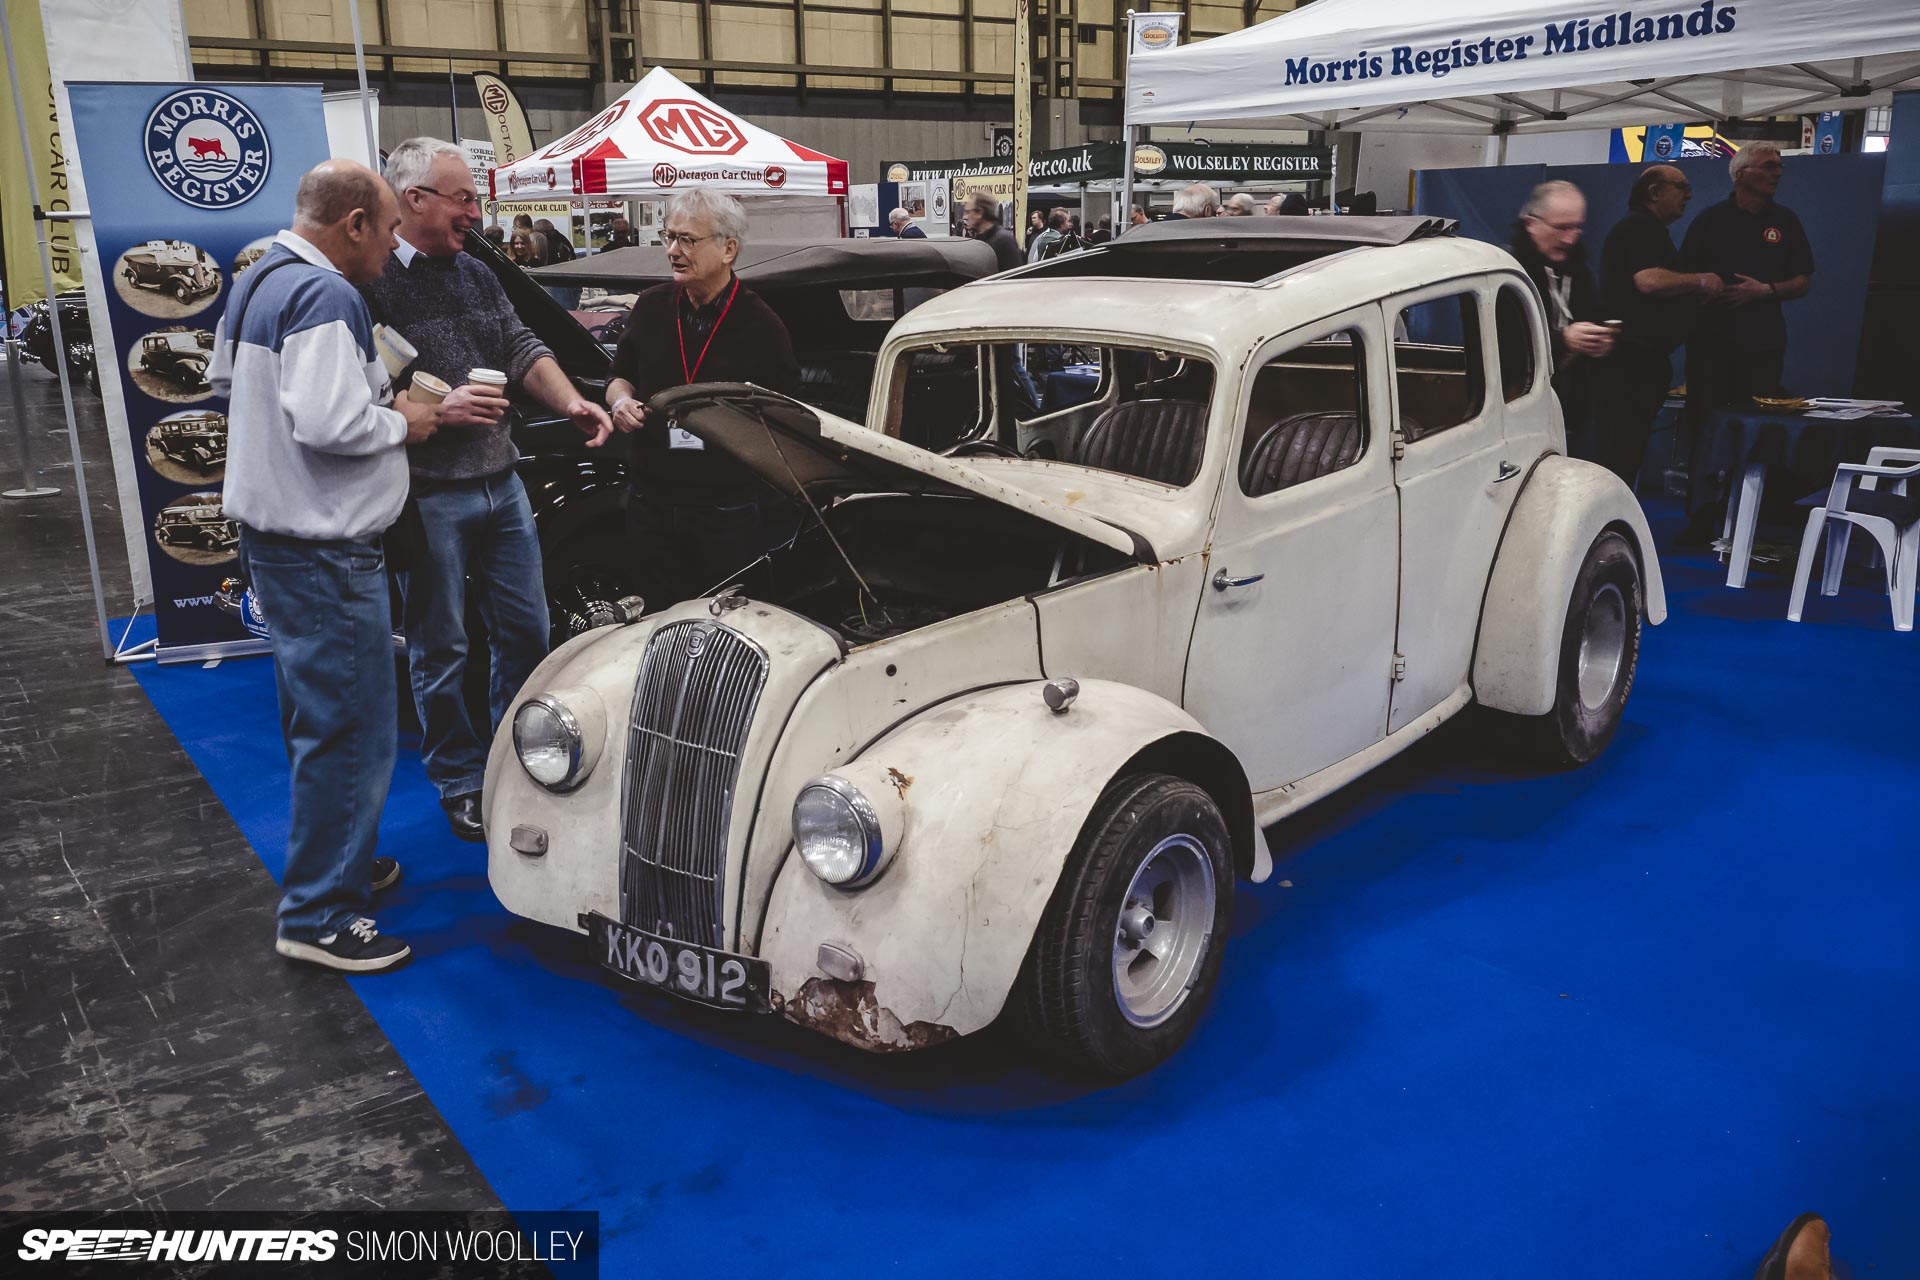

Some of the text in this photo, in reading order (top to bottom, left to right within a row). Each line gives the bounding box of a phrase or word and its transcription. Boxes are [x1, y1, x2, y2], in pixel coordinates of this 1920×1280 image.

[1284, 2, 1738, 86] Morris Register Midlands
[153, 96, 256, 140] MORRIS
[153, 148, 264, 202] REGISTER
[654, 167, 762, 185] MG Octagon Car Club
[1172, 155, 1320, 171] WOLSELEY REGISTER
[500, 202, 534, 212] OCTAGON
[535, 202, 548, 212] CAR
[549, 201, 568, 212] CLUB
[607, 924, 747, 1005] KKO 912
